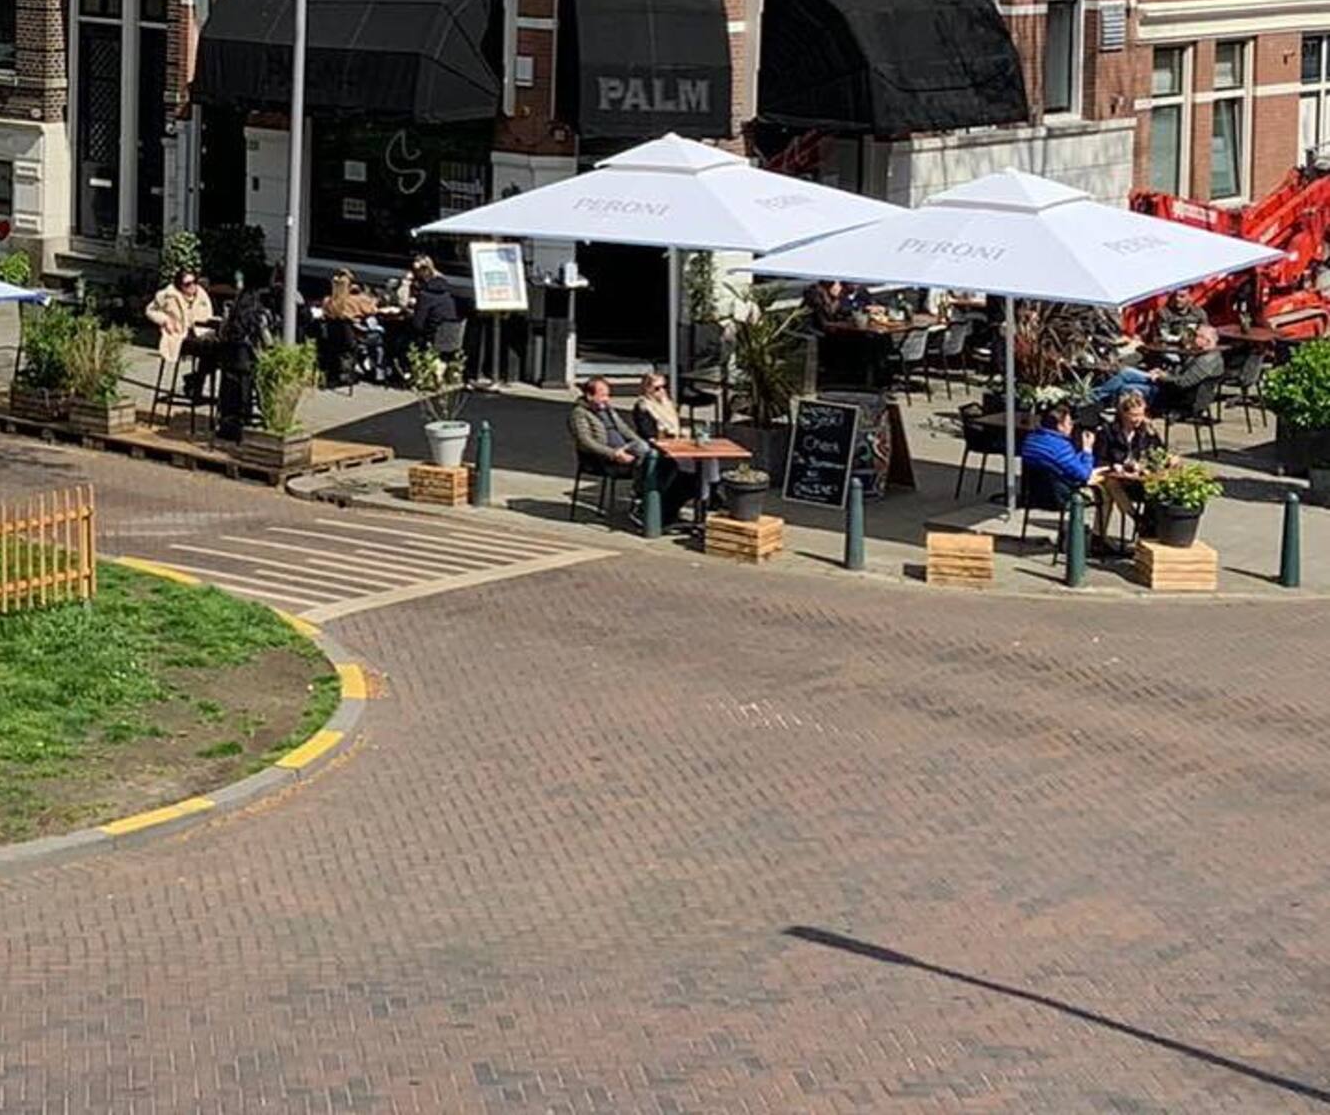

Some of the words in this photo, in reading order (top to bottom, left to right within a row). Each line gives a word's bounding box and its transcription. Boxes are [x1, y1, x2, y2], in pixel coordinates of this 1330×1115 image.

[598, 76, 711, 112] PALM
[573, 197, 670, 217] PERONI
[898, 237, 1006, 261] PERONI
